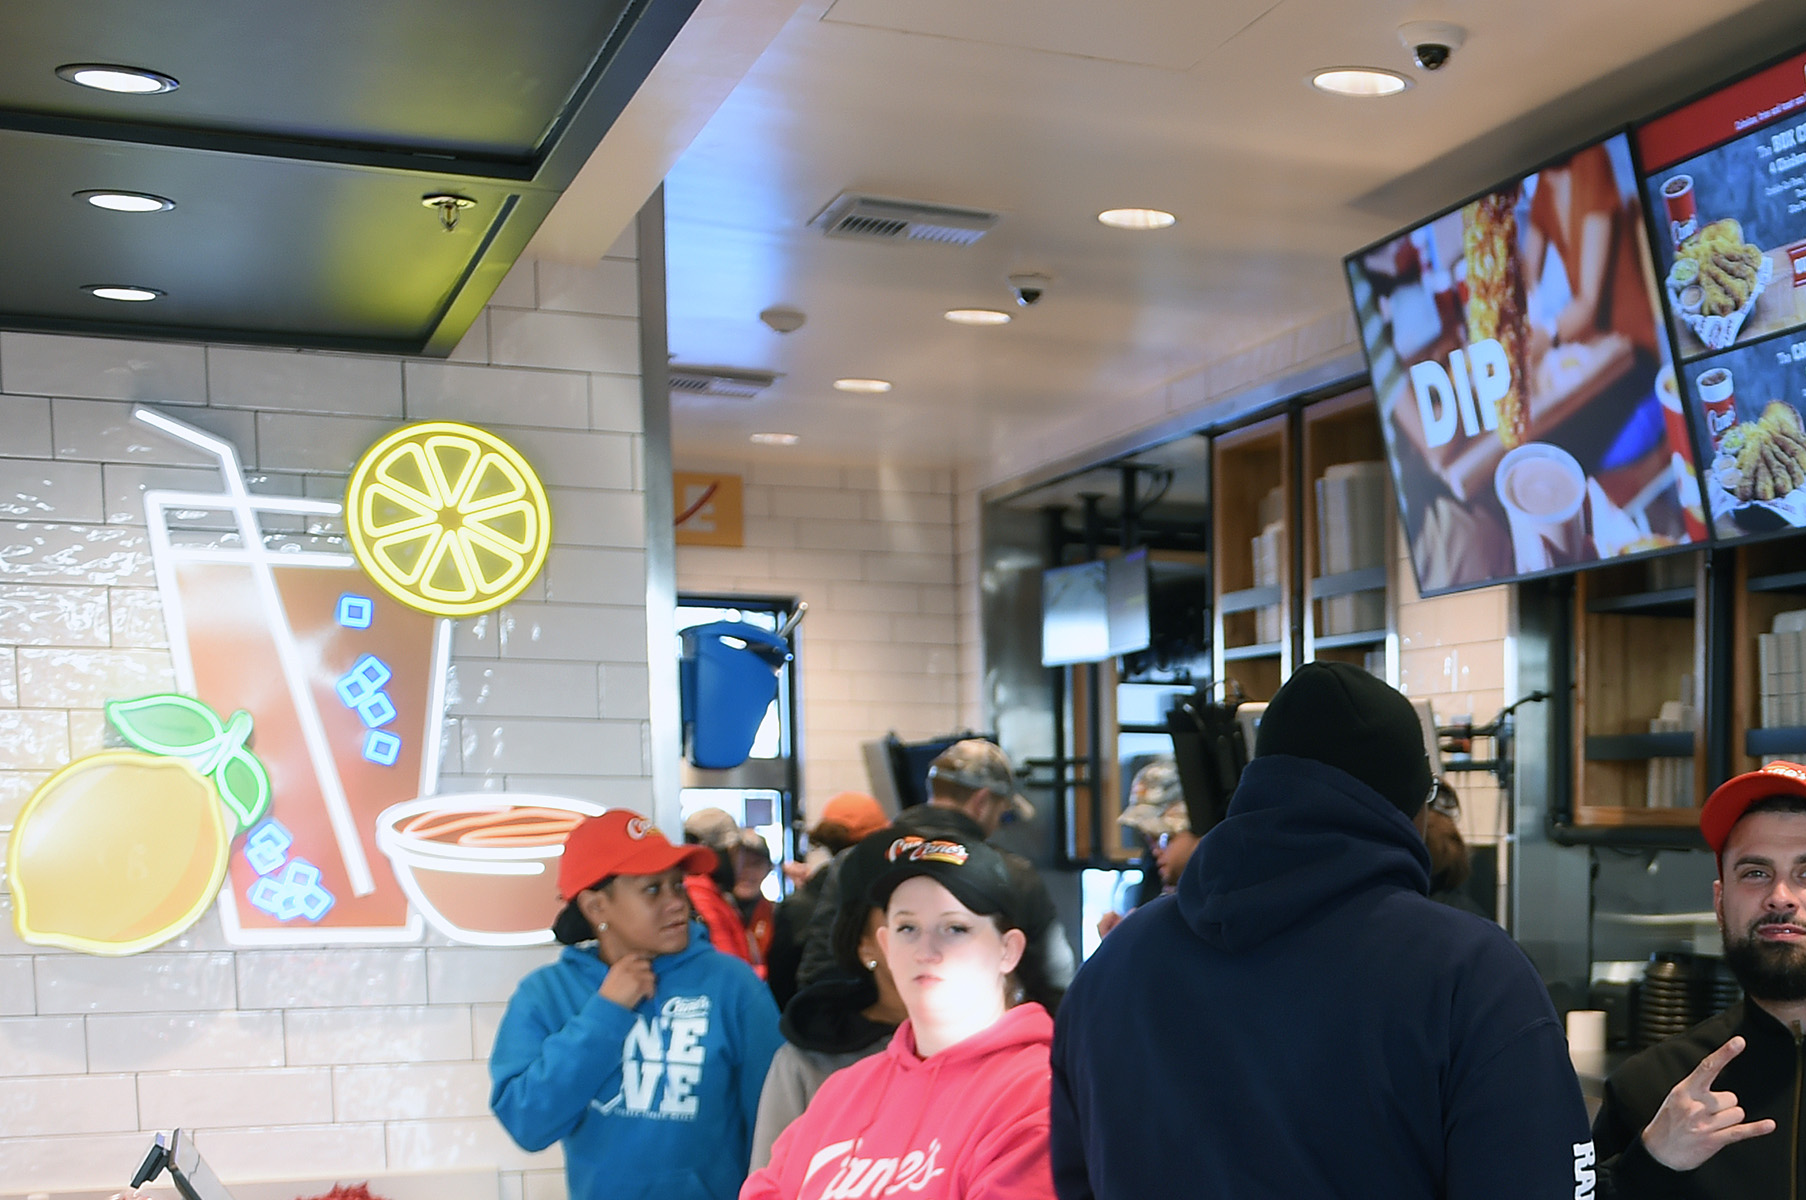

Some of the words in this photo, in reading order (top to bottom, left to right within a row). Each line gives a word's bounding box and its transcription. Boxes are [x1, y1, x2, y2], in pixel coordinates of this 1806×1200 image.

[1771, 129, 1796, 153] BOX
[1410, 337, 1512, 449] DIP
[622, 1013, 709, 1063] NE
